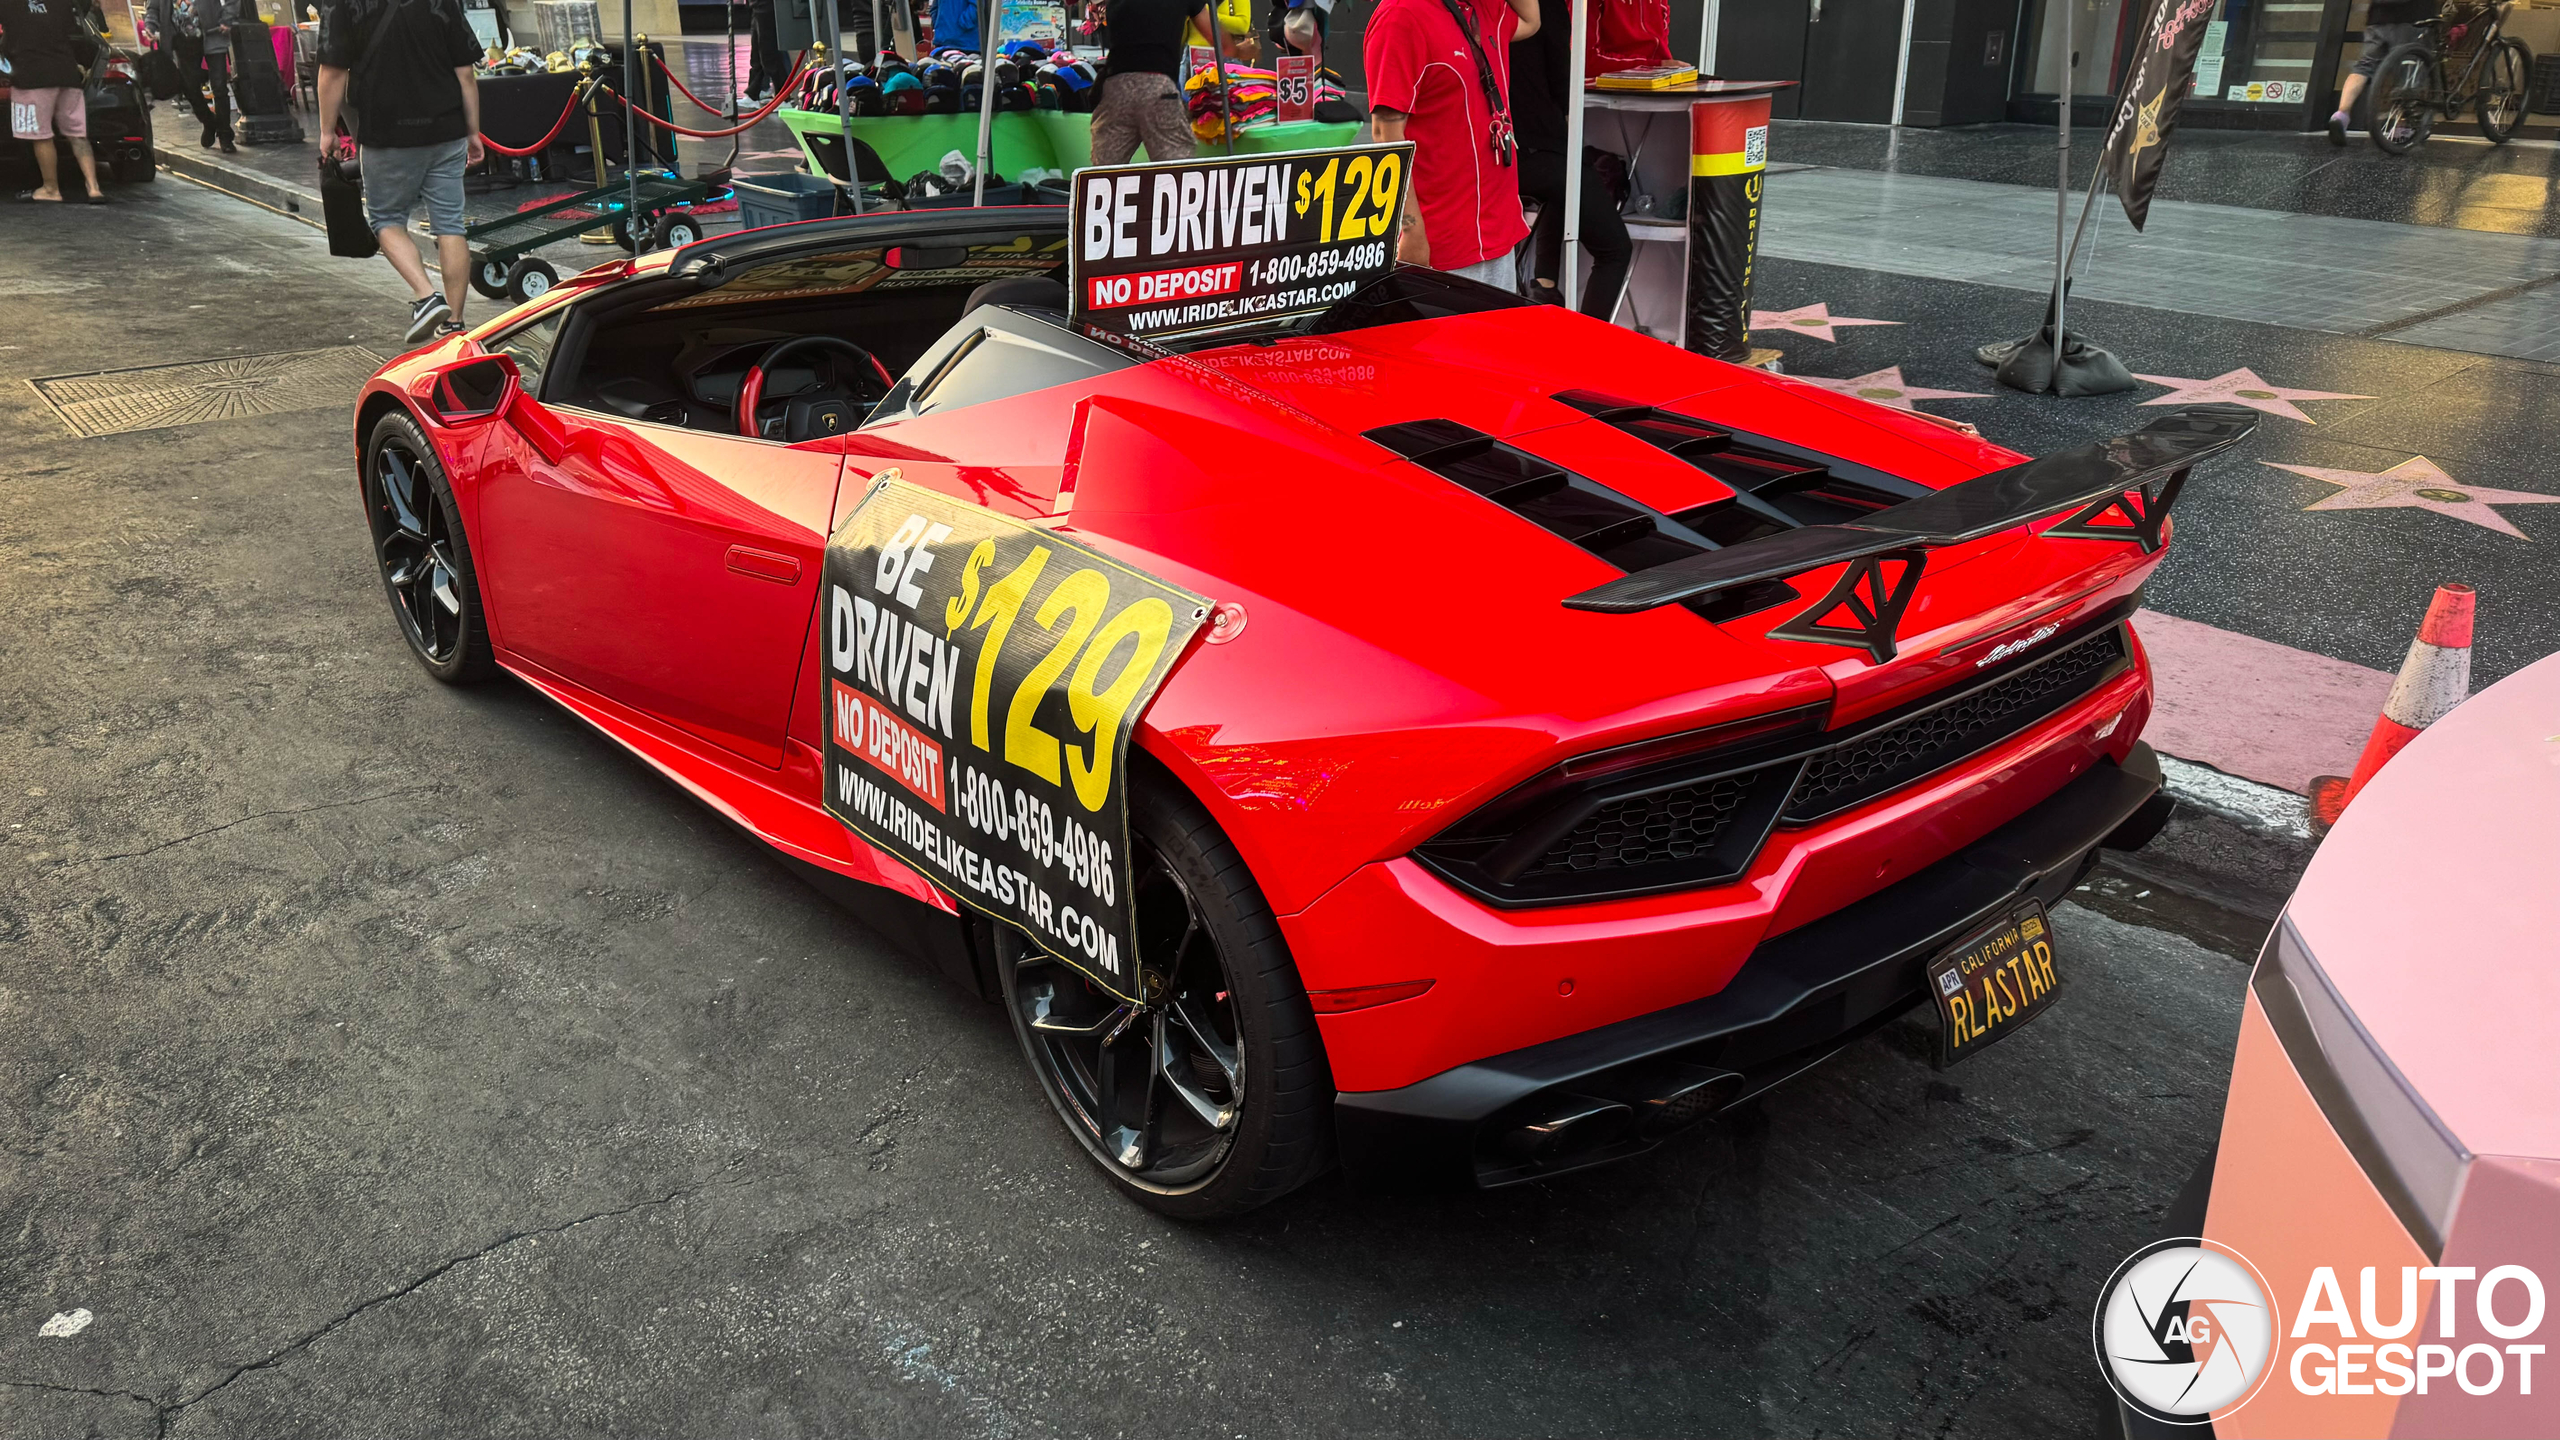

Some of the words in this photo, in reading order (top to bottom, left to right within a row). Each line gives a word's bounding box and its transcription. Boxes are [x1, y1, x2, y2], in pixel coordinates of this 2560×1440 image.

[1279, 76, 1308, 106] $5
[1085, 175, 1141, 262] BE
[1151, 163, 1292, 256] DRIVEN
[1295, 152, 1402, 244] $129
[1743, 207, 1757, 288] DRIVING
[1095, 277, 1131, 306] NO
[1138, 265, 1238, 301] DEPOSIT
[1249, 241, 1386, 287] 1-800-859-4986
[1128, 280, 1356, 331] WWW.IRIDELIKEASTAR.COM
[874, 513, 954, 612] BE
[831, 584, 961, 740] DRIVEN
[945, 534, 1174, 813] $129
[836, 689, 865, 741] NO
[868, 706, 940, 800] DEPOSIT
[838, 762, 1121, 977] WWW.IRIDELIKEASTAR.COM
[949, 754, 1115, 909] 1-800-859-4986
[1941, 970, 1960, 992] APR
[1948, 940, 2057, 1049] RLASTAR
[1960, 927, 2020, 975] CALIFORNIA
